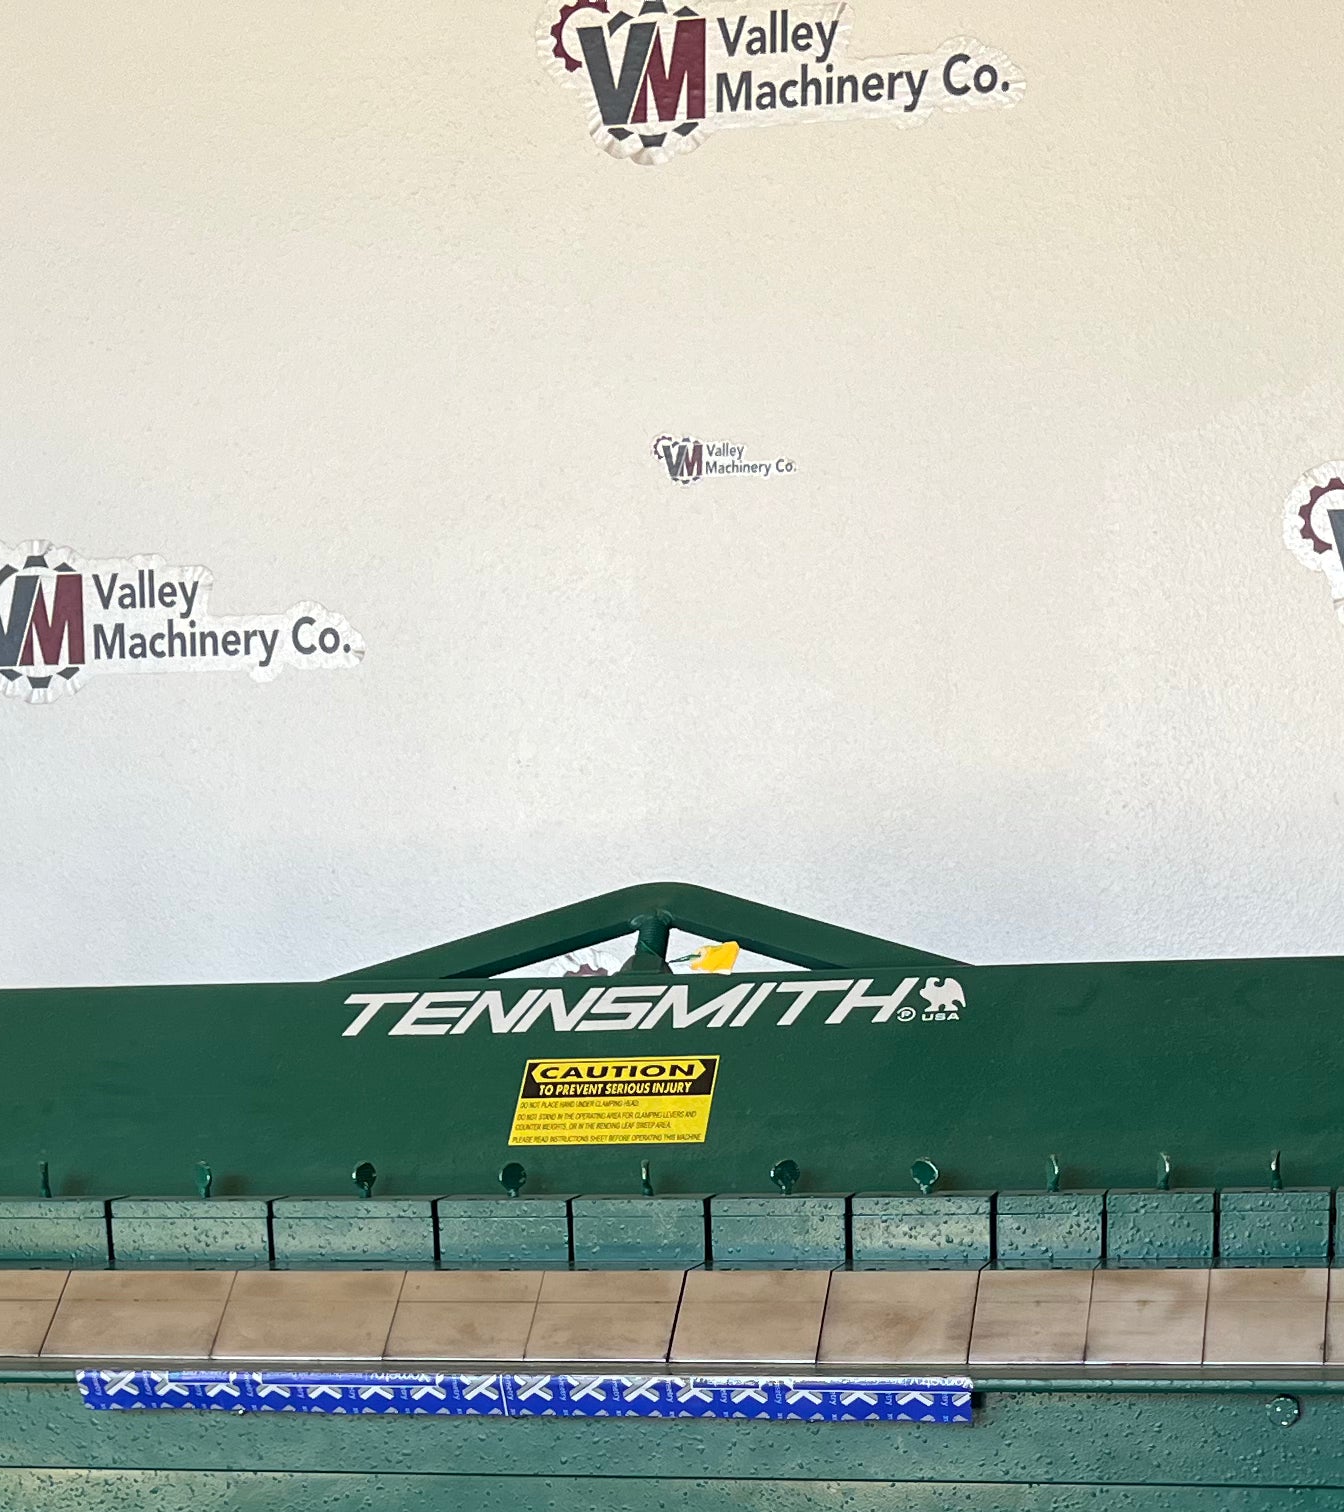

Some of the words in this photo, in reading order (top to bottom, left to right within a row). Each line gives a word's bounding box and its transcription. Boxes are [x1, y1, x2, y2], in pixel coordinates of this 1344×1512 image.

[716, 10, 839, 63] Valley
[576, 17, 706, 126] VM
[715, 64, 928, 113] Machinery
[942, 54, 1009, 95] Co.
[662, 444, 703, 477] VM
[705, 460, 772, 477] Machinery
[775, 459, 797, 473] Co.
[706, 443, 744, 460] Valley
[92, 569, 199, 619] Valley
[93, 618, 279, 667] Machinery
[292, 616, 351, 655] Co.
[921, 1012, 960, 1022] USA
[539, 1063, 695, 1080] CAUTION
[539, 1084, 554, 1096] TO
[556, 1082, 604, 1095] PREVENT
[605, 1082, 650, 1095] SERIOUS
[652, 1081, 692, 1093] INJURY
